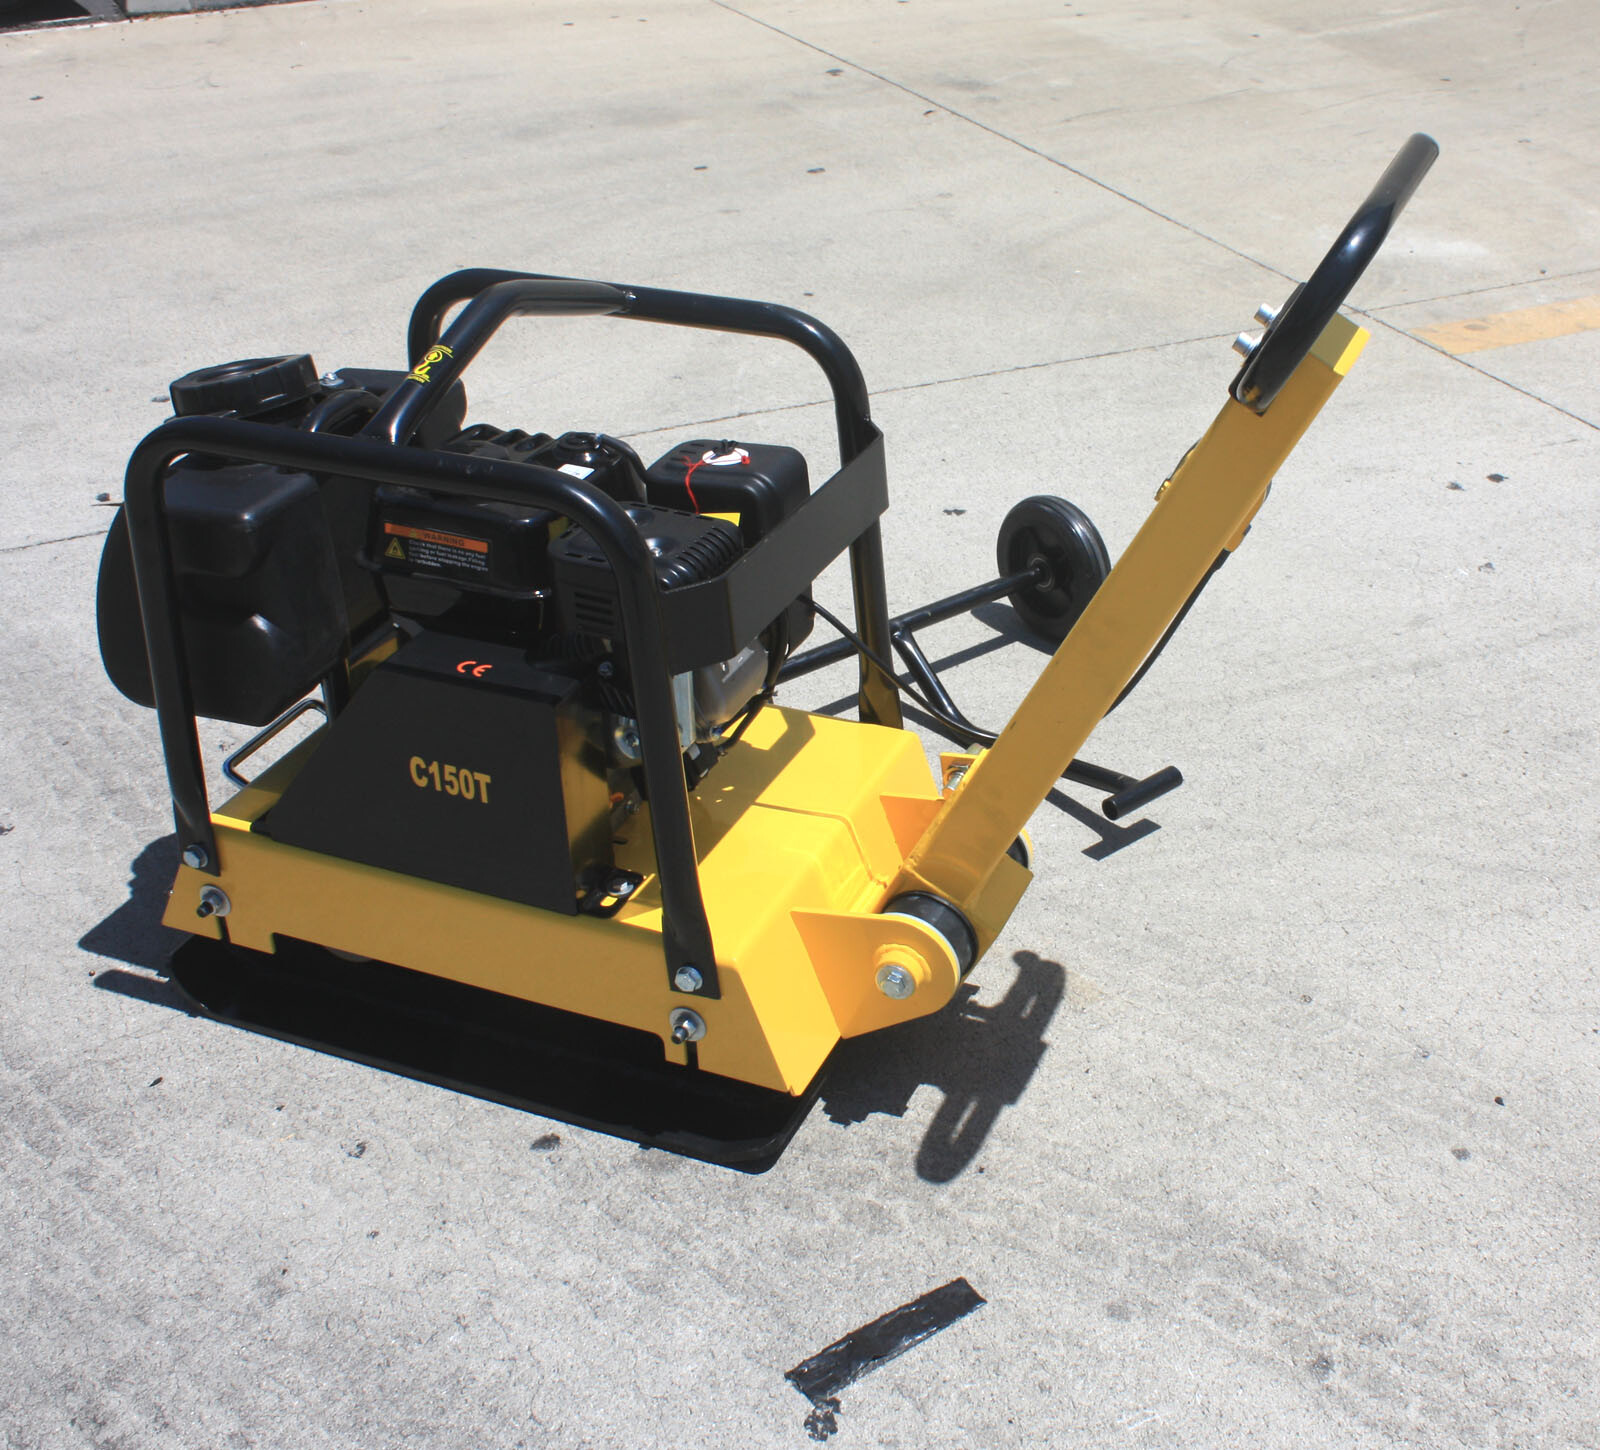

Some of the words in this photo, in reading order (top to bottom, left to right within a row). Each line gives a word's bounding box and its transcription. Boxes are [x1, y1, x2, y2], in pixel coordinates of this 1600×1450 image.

[423, 532, 465, 546] WARNING
[456, 660, 493, 677] CE
[409, 756, 492, 804] C150T
